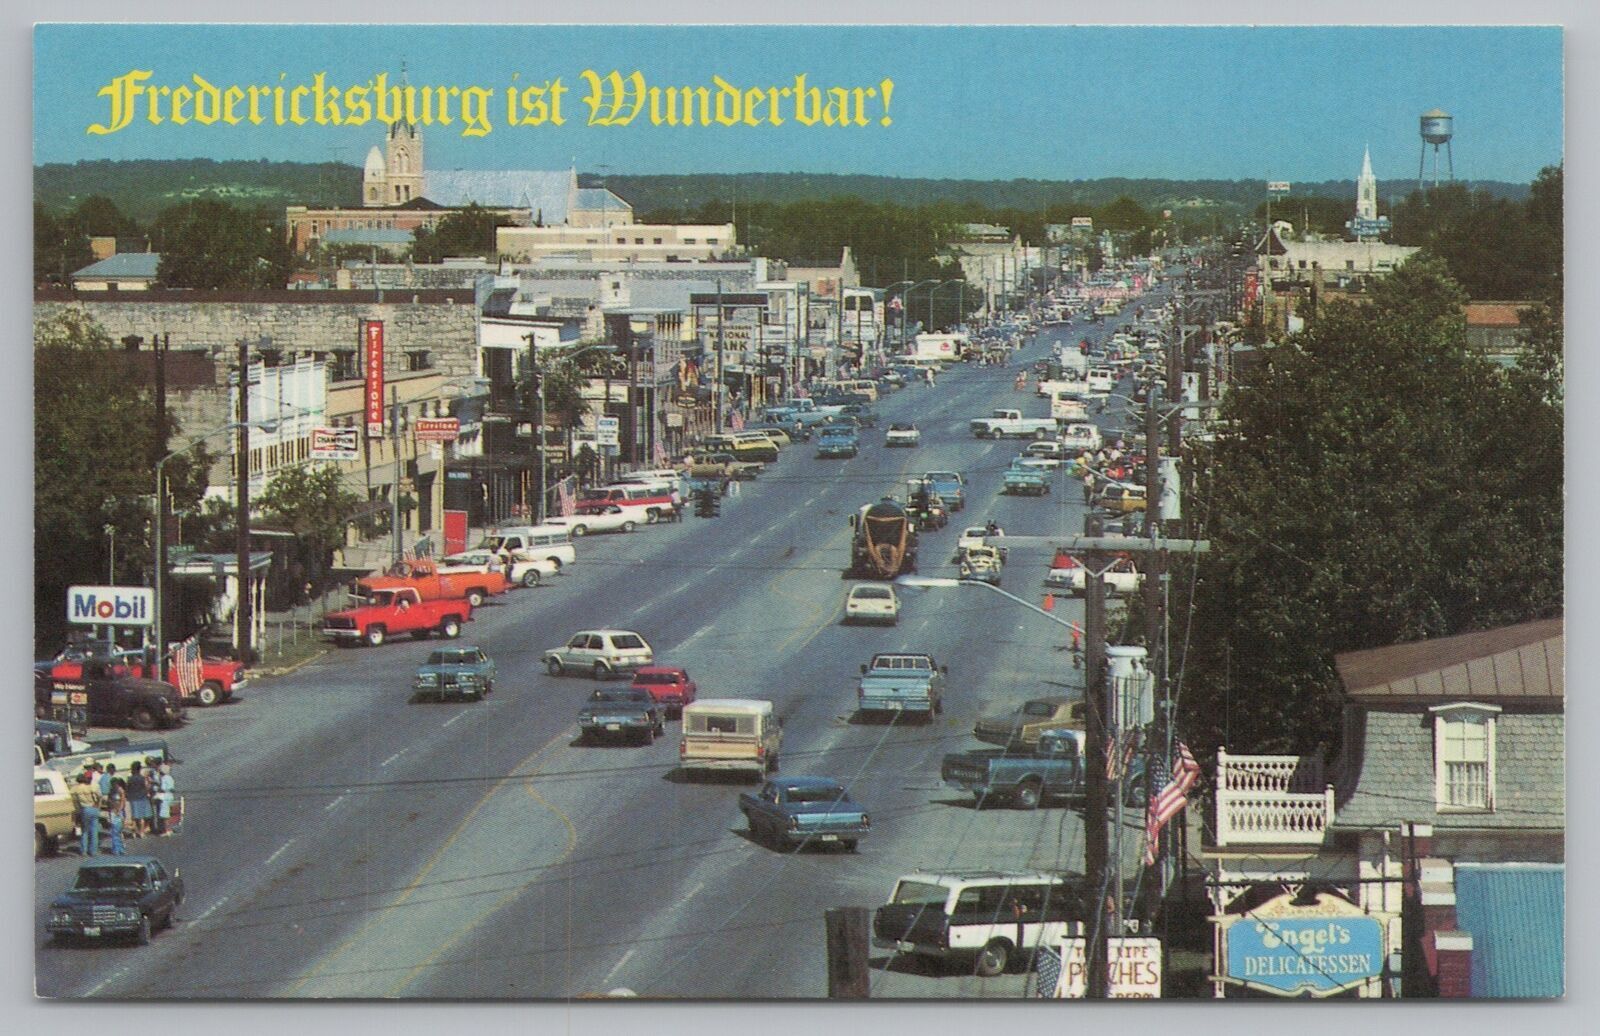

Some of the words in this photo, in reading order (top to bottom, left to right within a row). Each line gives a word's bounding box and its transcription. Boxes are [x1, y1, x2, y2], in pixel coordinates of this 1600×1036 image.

[709, 331, 752, 339] NAIONAL
[75, 594, 146, 618] Mobil
[1255, 922, 1351, 954] Engel's
[1244, 954, 1371, 976] DELICATESSEN
